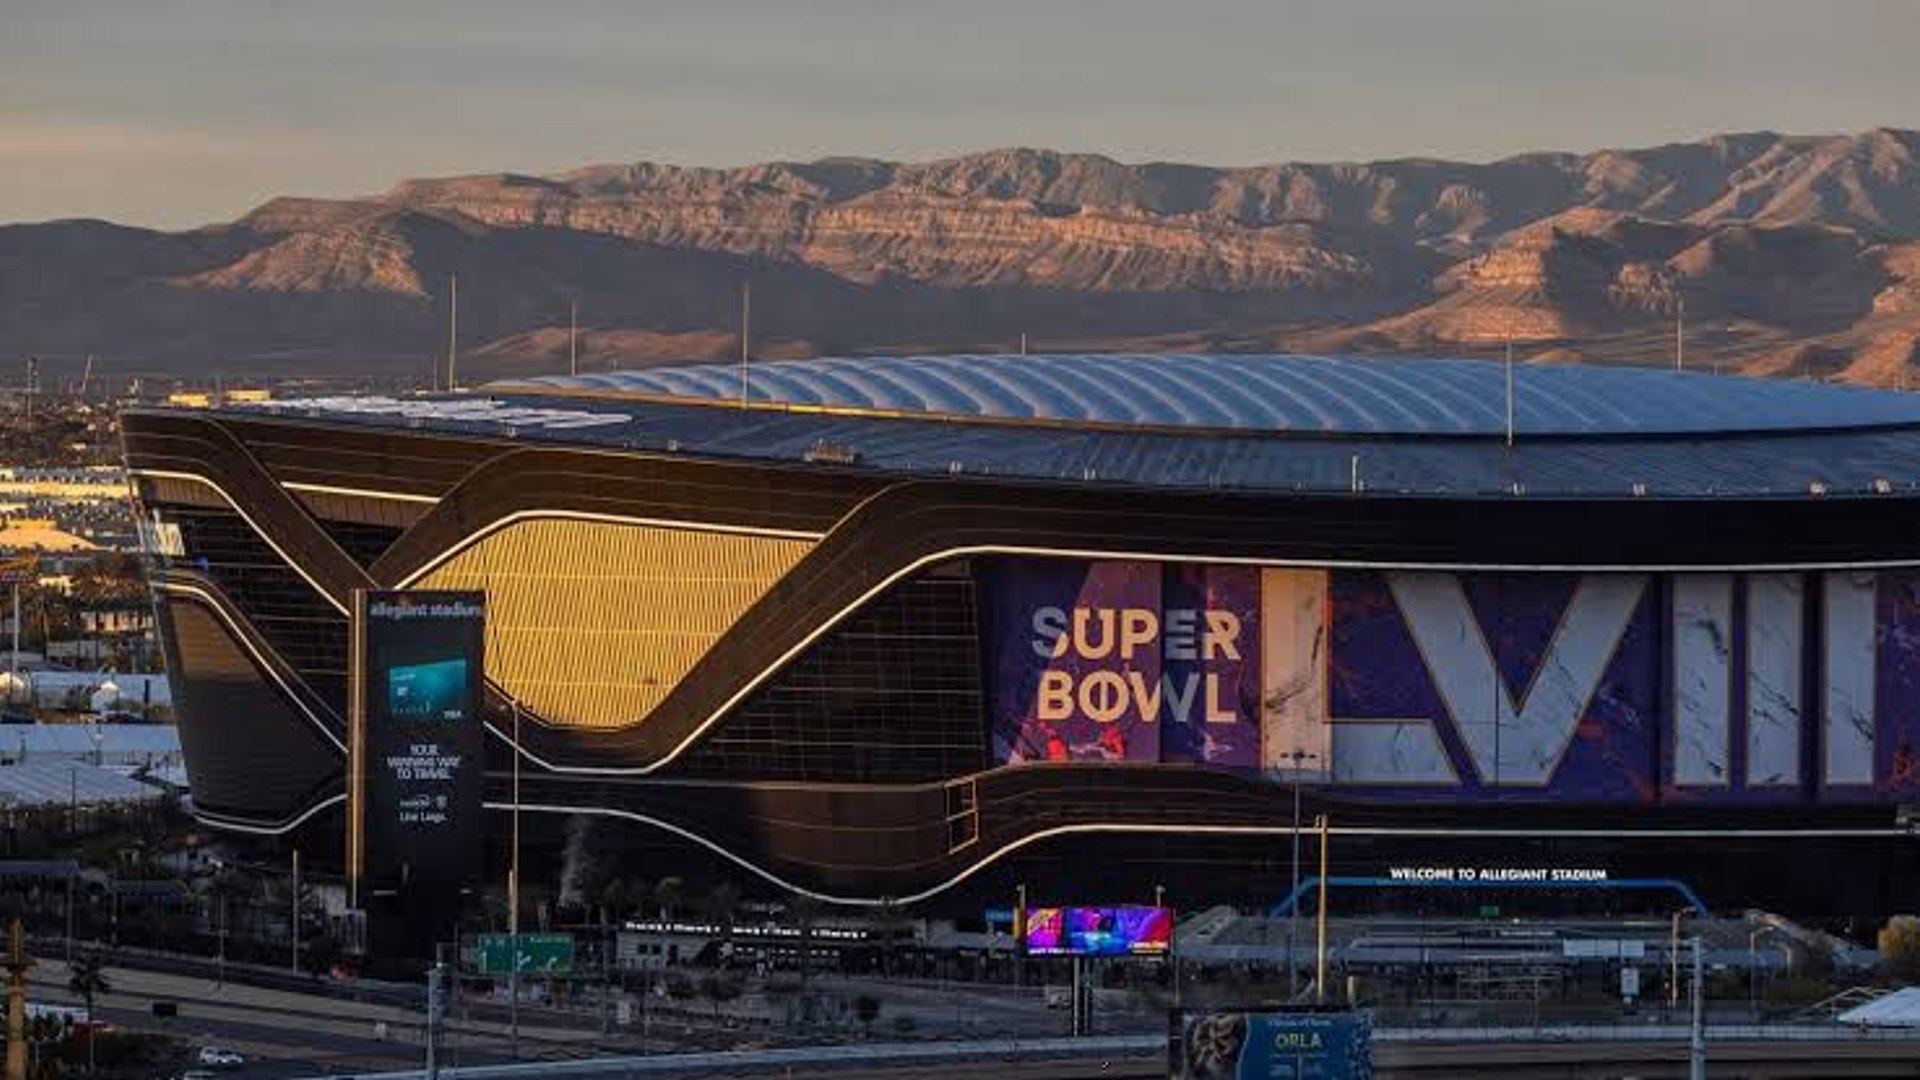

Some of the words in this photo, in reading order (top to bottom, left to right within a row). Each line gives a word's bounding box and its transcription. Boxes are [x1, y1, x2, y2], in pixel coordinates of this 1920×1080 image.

[1032, 606, 1242, 660] SUPER
[1038, 669, 1237, 722] BOWL
[1390, 868, 1453, 881] WELCOME
[1457, 868, 1475, 881] TO
[1479, 868, 1548, 881] ALLEGIANT
[1551, 868, 1608, 881] STADIUM
